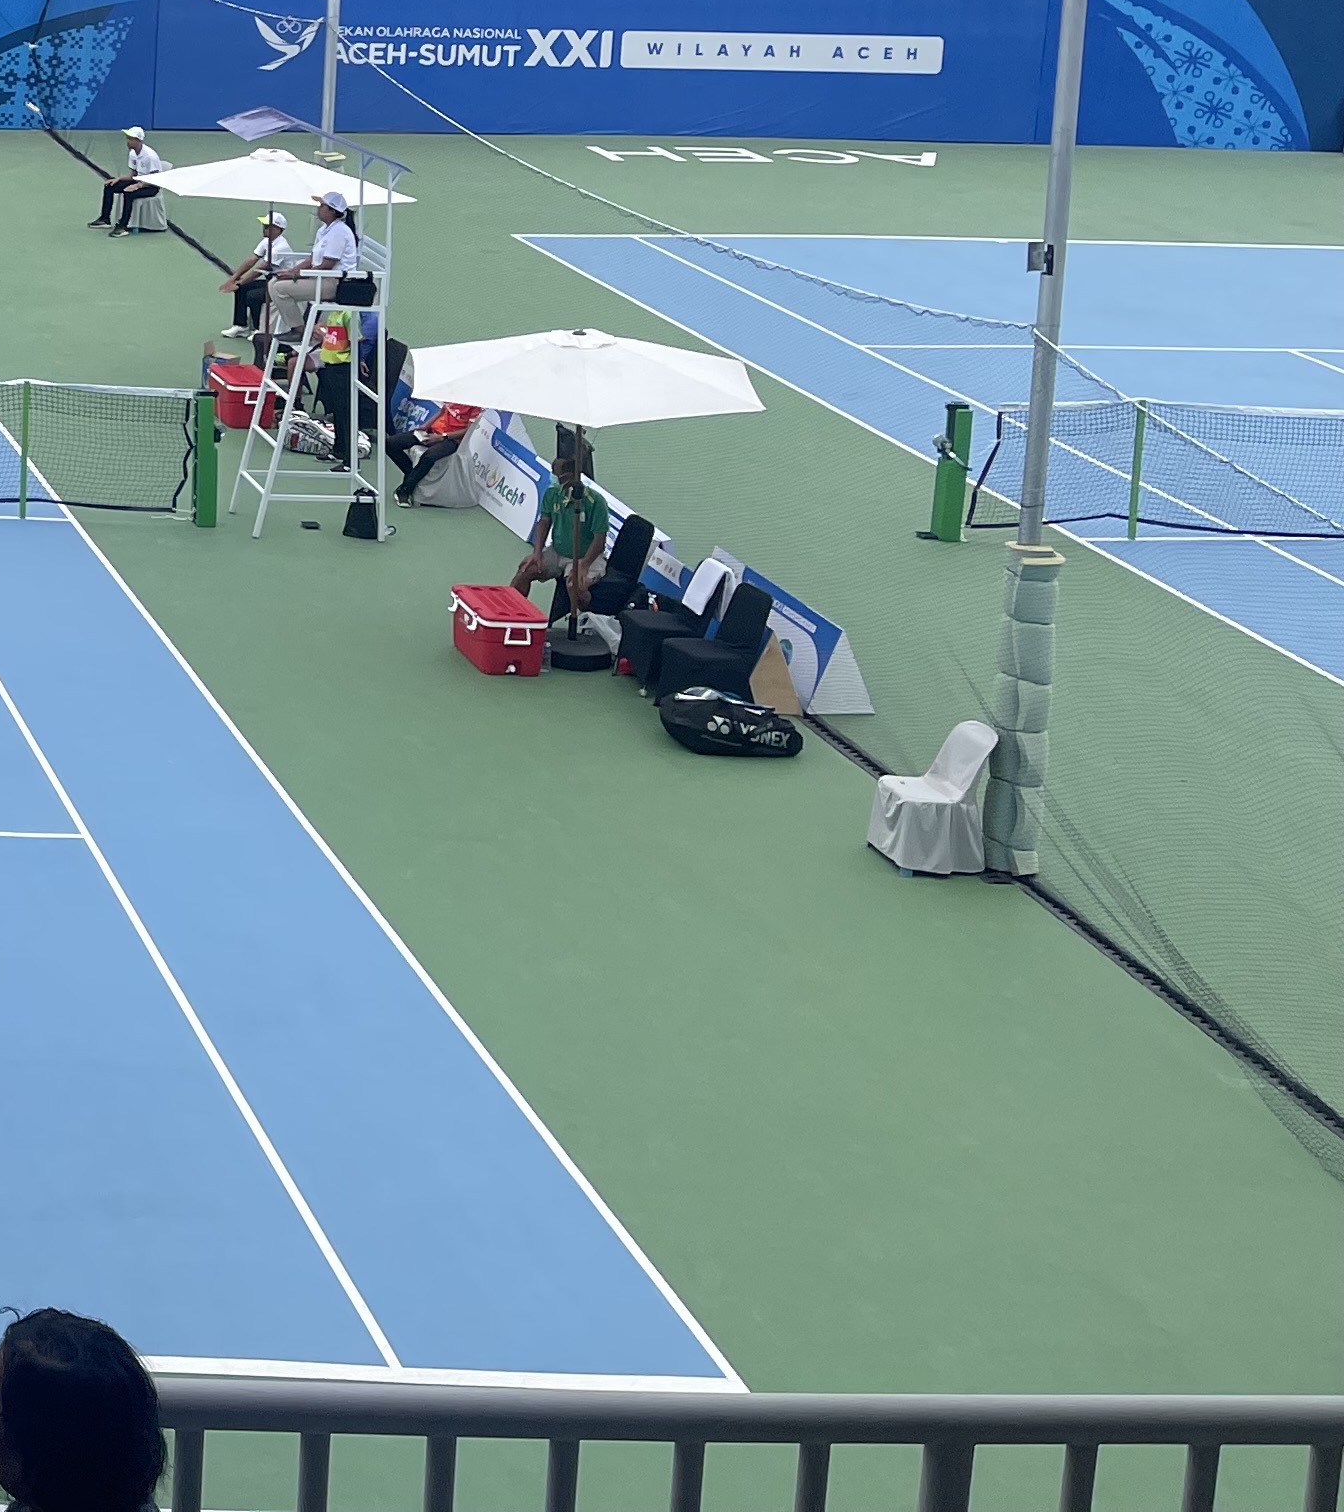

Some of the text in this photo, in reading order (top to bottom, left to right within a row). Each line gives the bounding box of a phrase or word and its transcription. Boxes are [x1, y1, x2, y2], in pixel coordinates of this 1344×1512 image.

[337, 26, 522, 40] EKAN OLAHRAGA NASIONAL
[336, 28, 614, 69] ACEH-SUMUT XXI
[647, 42, 919, 61] WILAYAH ACEH
[586, 145, 937, 167] ACEH
[495, 475, 519, 507] Aceh
